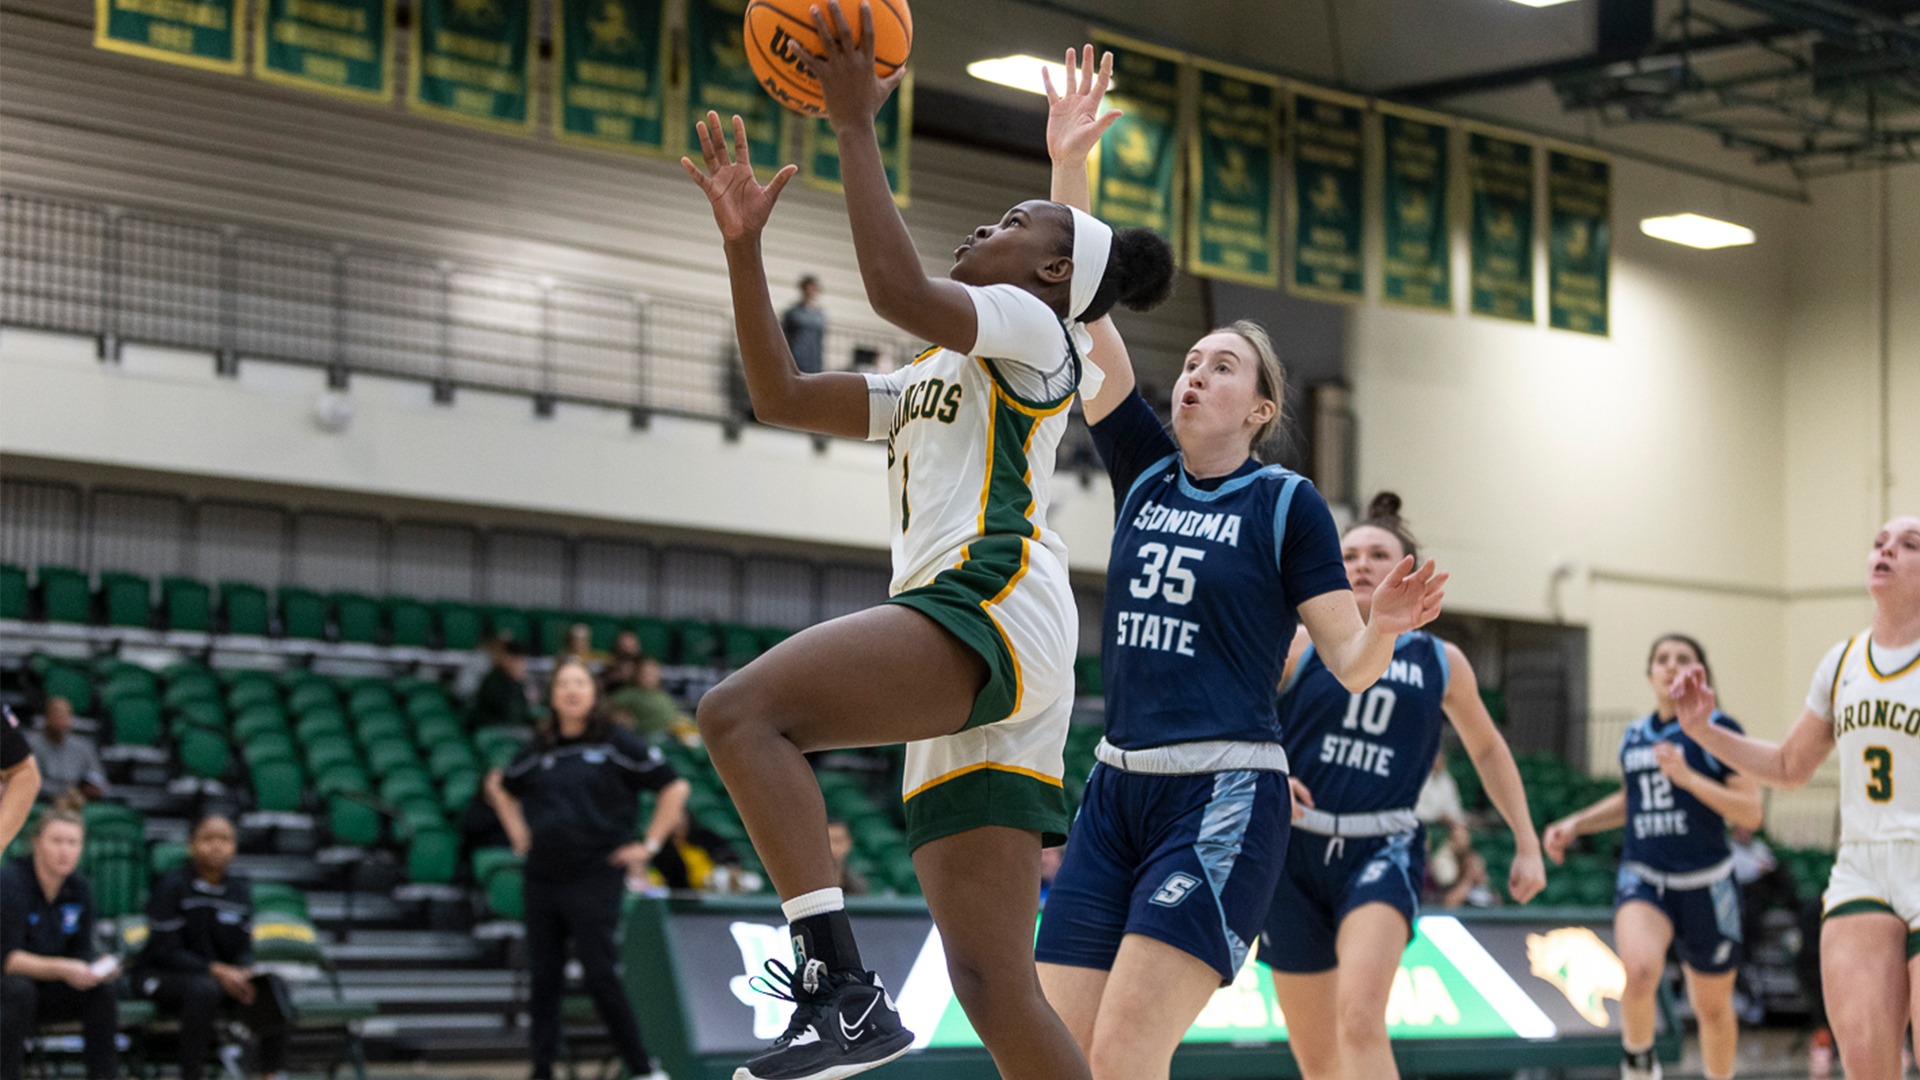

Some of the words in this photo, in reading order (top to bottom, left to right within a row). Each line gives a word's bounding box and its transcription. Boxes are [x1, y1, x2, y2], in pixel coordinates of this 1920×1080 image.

[902, 450, 911, 536] 1
[1132, 500, 1242, 548] SONOMA
[1129, 541, 1206, 606] 35
[1117, 611, 1200, 657] STATE
[1342, 685, 1397, 736] 10
[1836, 698, 1920, 737] BRONCO
[1319, 732, 1395, 777] STATE
[1863, 743, 1894, 804] 3
[1638, 771, 1675, 811] 12
[1152, 872, 1200, 905] S
